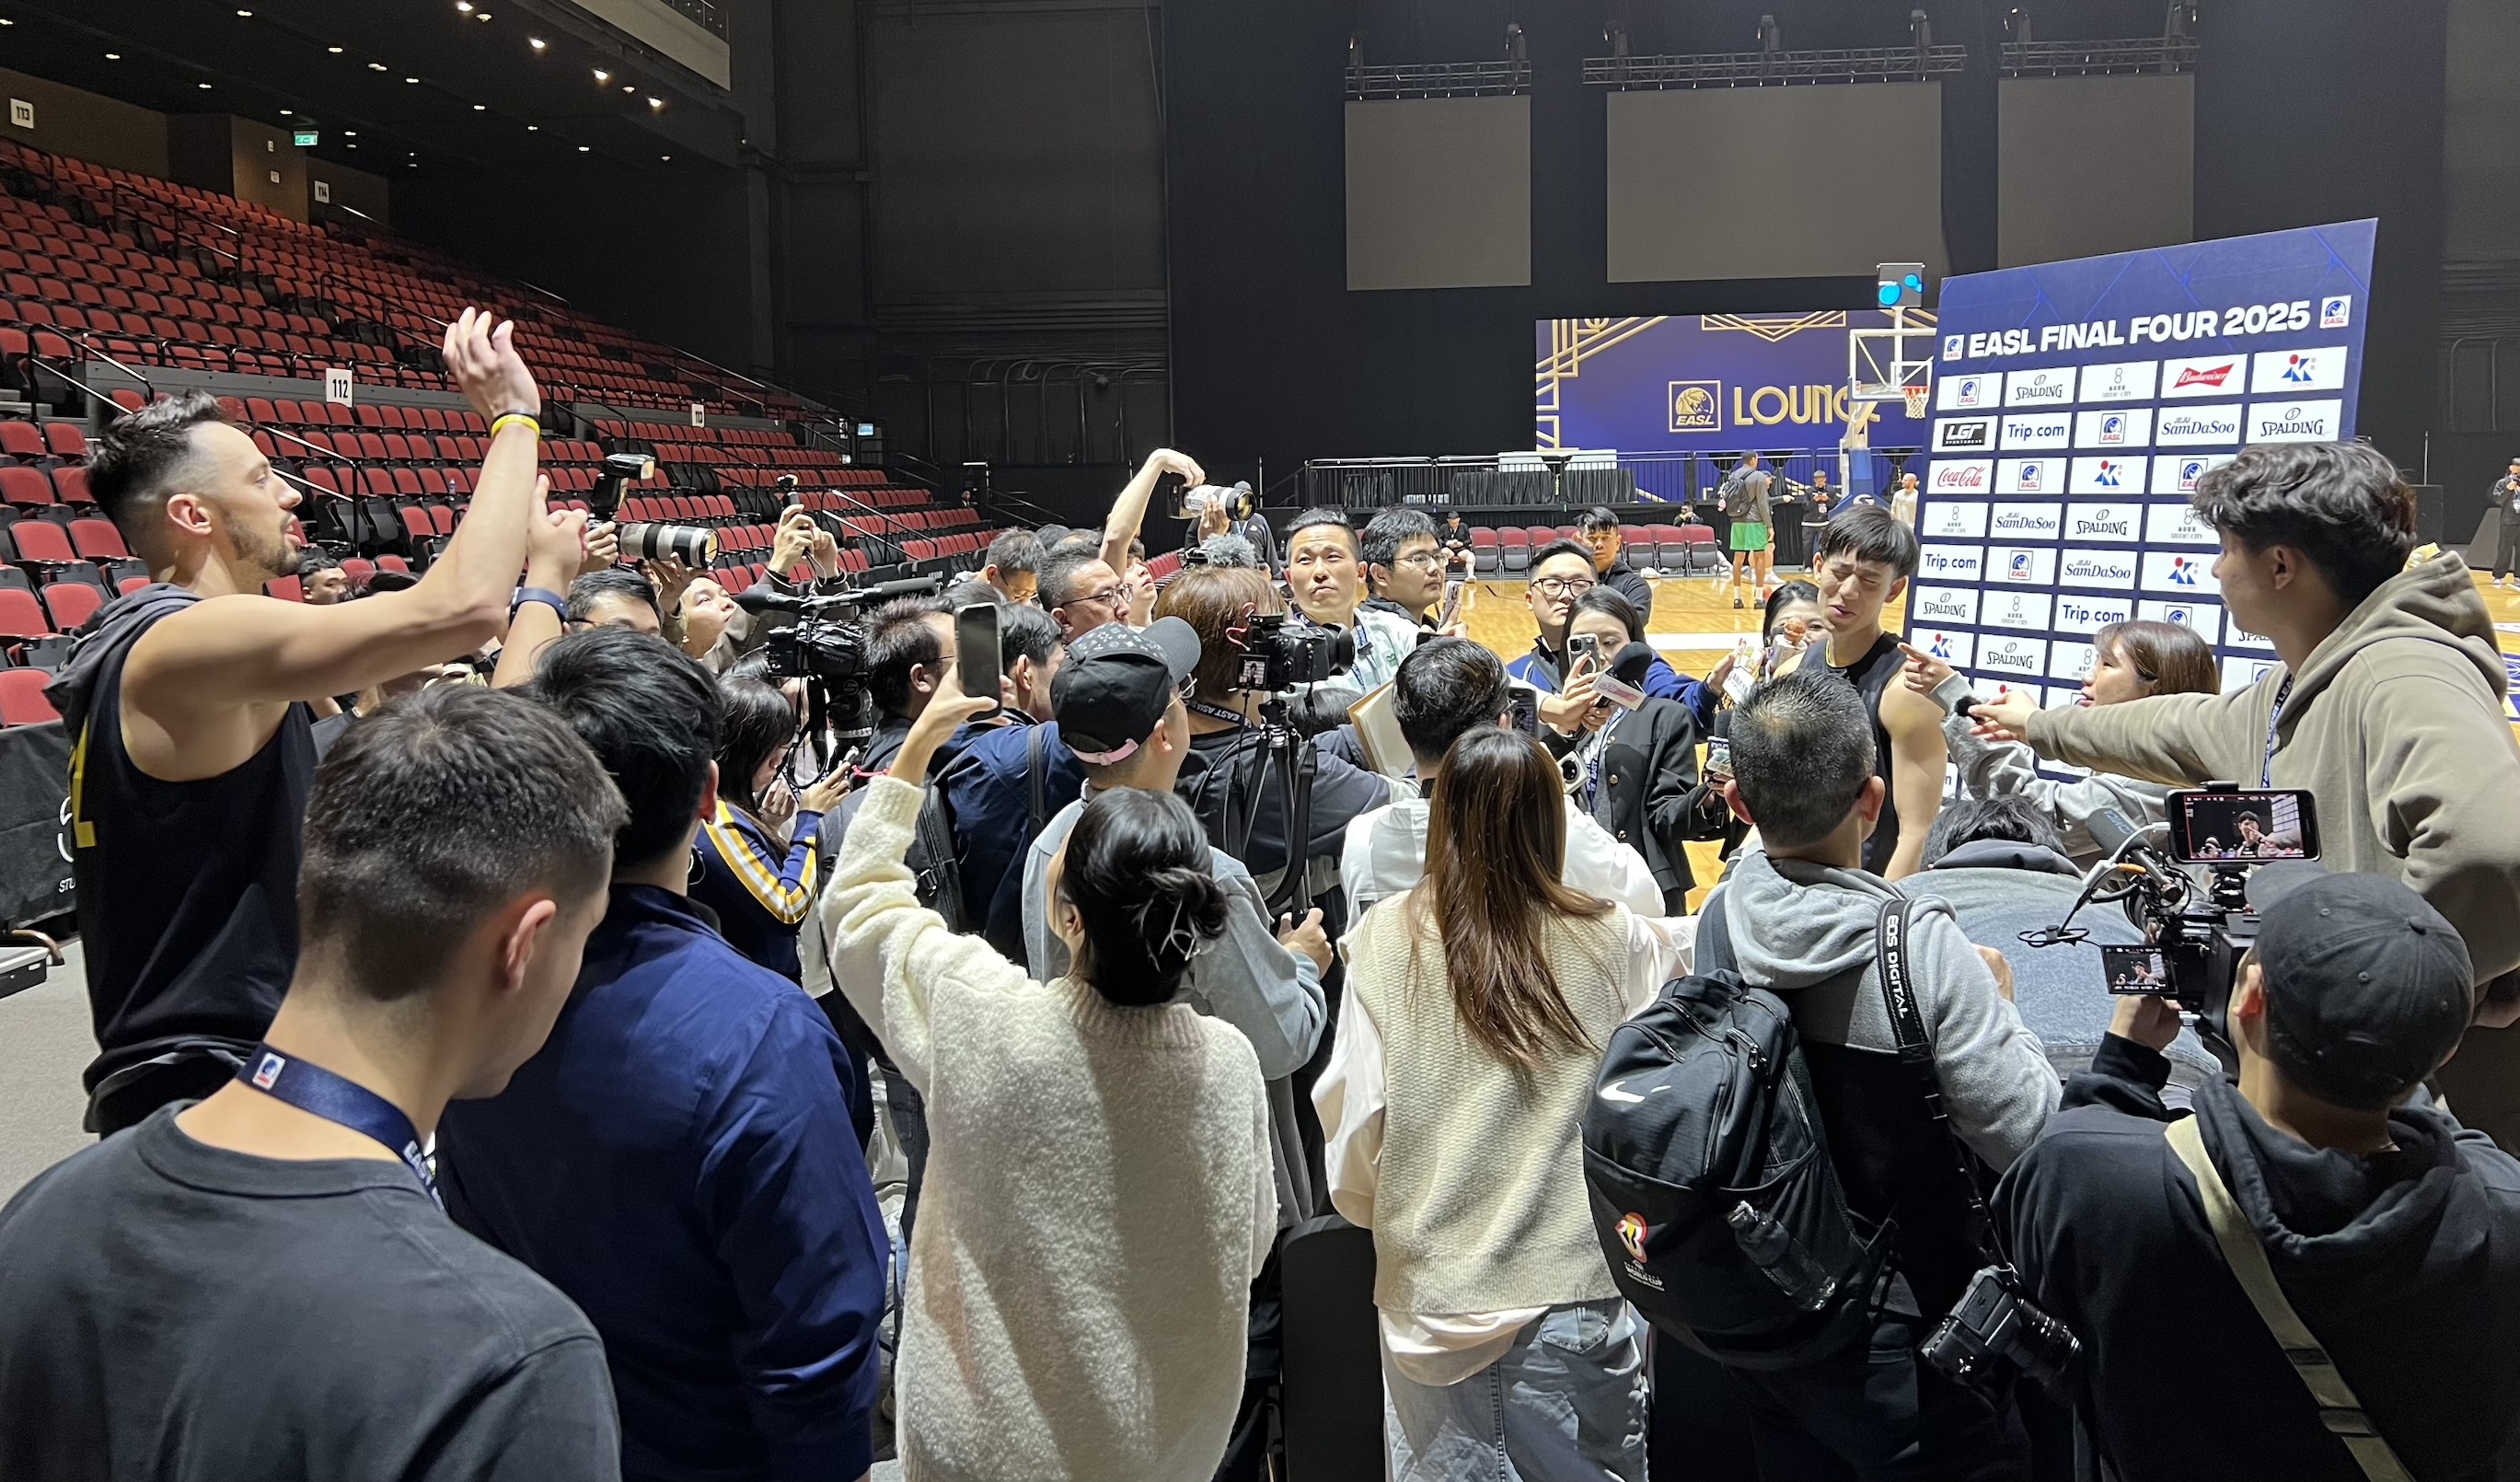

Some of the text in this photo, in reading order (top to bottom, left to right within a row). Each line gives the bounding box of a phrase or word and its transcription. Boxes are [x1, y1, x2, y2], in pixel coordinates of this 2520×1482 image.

[16, 106, 29, 121] 113
[1968, 299, 2311, 359] EASL FINAL FOUR 2025
[2179, 369, 2229, 384] Budweiser
[332, 378, 349, 399] 112
[2015, 383, 2063, 400] SPALDING
[1734, 384, 1880, 425] LOUNG
[1675, 414, 1715, 426] EASL
[2161, 421, 2236, 435] SamDaSoo
[2173, 416, 2191, 424] JEJU
[2260, 419, 2324, 437] SPALDING
[2007, 424, 2065, 442] Trip.com
[1995, 516, 2056, 530] SamDaSoo
[2075, 520, 2128, 536] SPALDING
[1925, 553, 1977, 571] Trip.com
[2064, 563, 2131, 579] SamDaSoo
[1923, 601, 1967, 619] SPALDING
[2062, 604, 2125, 624] Trip.com
[1986, 652, 2034, 670] SPALDING
[1214, 709, 1241, 722] EAST
[1886, 914, 1909, 1019] EOS DIGITAL
